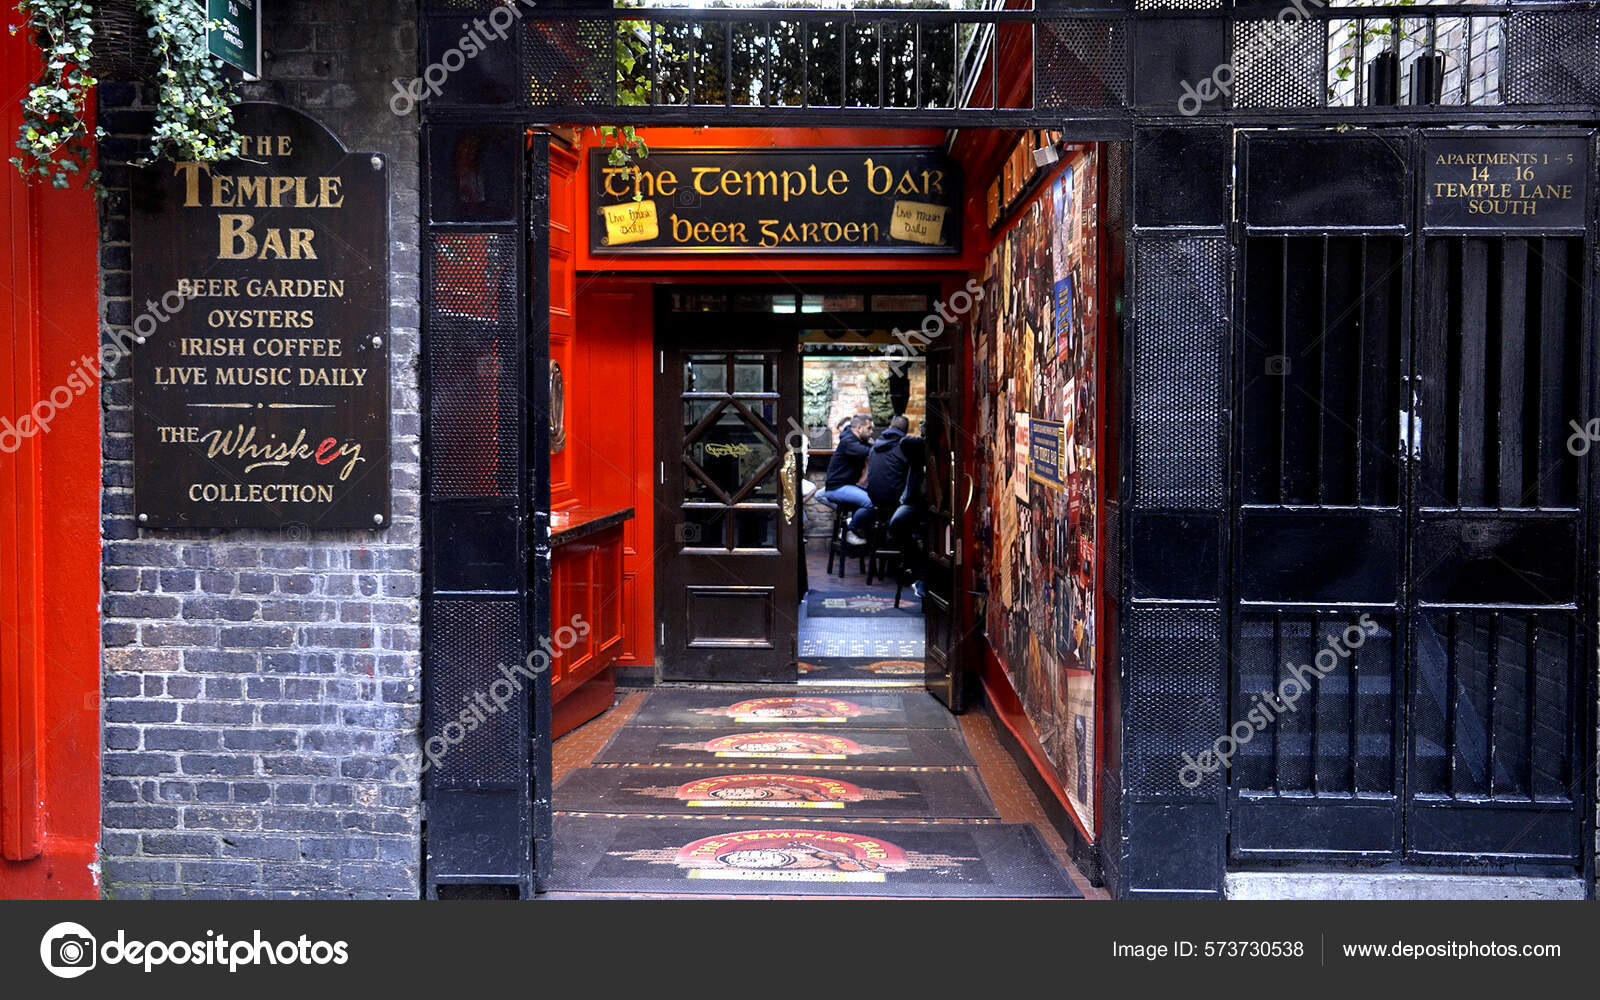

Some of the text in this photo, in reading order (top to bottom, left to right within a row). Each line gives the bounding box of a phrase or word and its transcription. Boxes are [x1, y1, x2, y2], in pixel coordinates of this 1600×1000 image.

[240, 135, 293, 157] THE
[1435, 153, 1538, 165] APARTMENTS
[1543, 154, 1549, 165] 1
[1567, 154, 1574, 165] 5
[691, 163, 850, 202] Temple
[1471, 166, 1535, 182] 14 16
[173, 160, 345, 209] TEMPLE
[1434, 183, 1573, 199] TEMPLE LANE
[1468, 199, 1537, 215] SOUTH
[216, 214, 320, 261] BAR
[177, 279, 345, 299] BEER GARDEN
[208, 309, 314, 328] OYSTERS
[180, 338, 342, 356] IRISH COFFEE
[155, 367, 368, 386] LIVE MUSIC DAILY
[157, 424, 366, 481] THE Whiskey
[189, 484, 335, 503] COLLECTION
